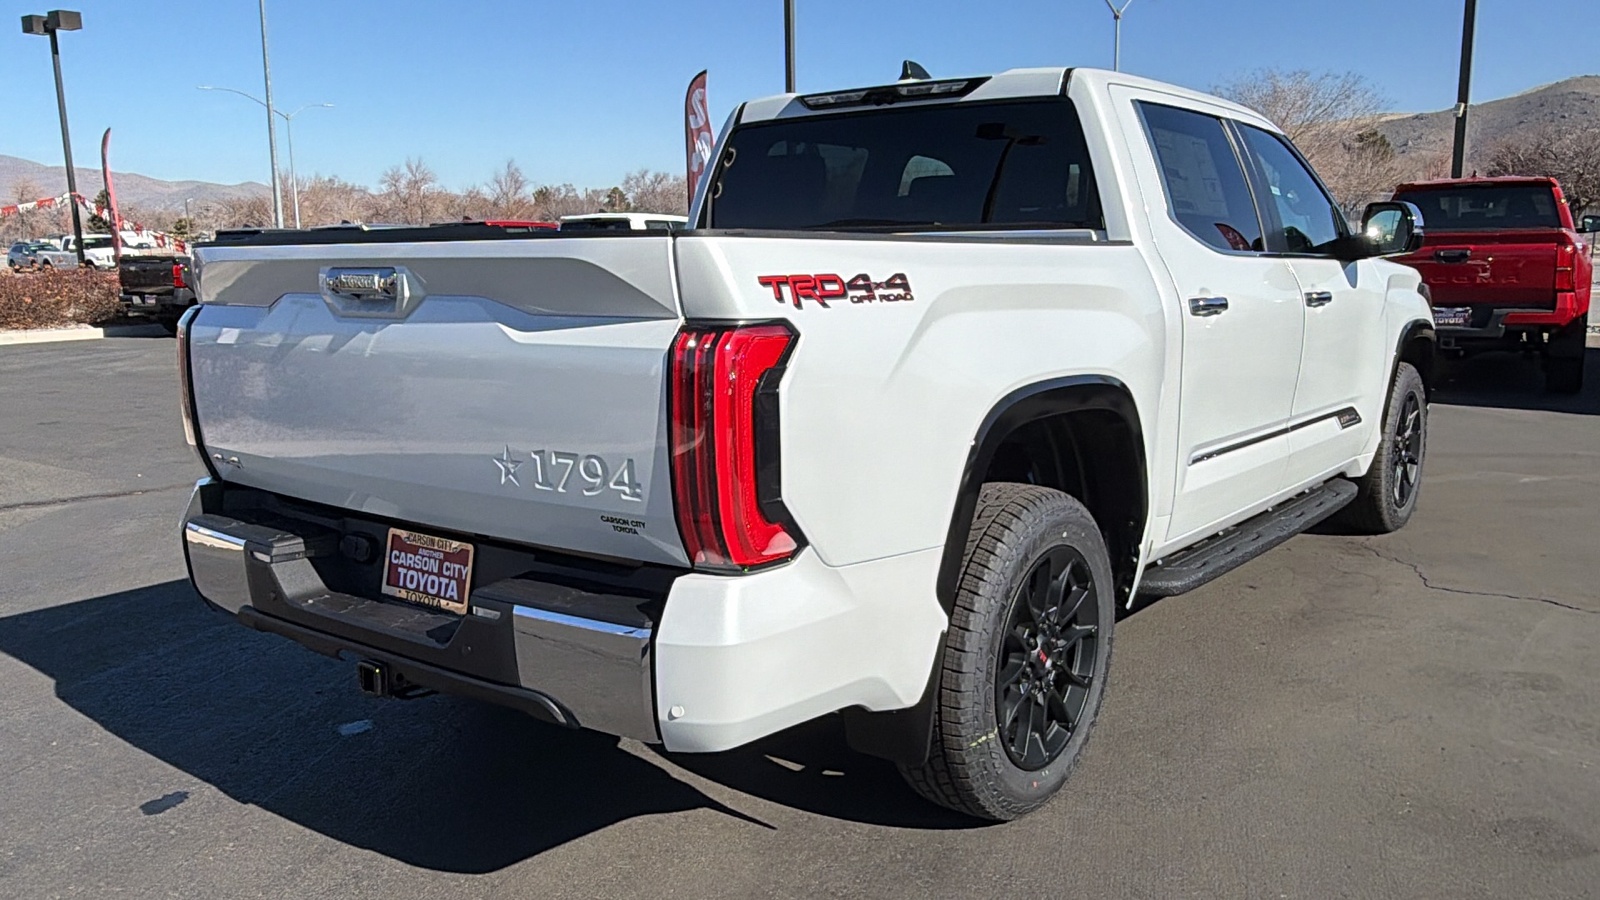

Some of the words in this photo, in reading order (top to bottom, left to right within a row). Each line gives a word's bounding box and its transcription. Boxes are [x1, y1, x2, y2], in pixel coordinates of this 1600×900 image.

[757, 274, 848, 310] TRD
[846, 273, 912, 297] 4x4
[850, 294, 877, 304] OFF
[879, 292, 914, 303] ROAD
[531, 449, 642, 502] 1794
[600, 515, 630, 526] CARSON
[630, 520, 646, 529] CITY
[612, 525, 639, 535] TOYOTA
[408, 533, 436, 548] CARSON
[437, 537, 454, 551] CITY
[418, 548, 444, 560] ANOTHER
[391, 550, 439, 573] CARSON
[442, 561, 469, 580] CITY
[398, 567, 459, 600] TOYOTA
[405, 590, 442, 608] TOYOTA
